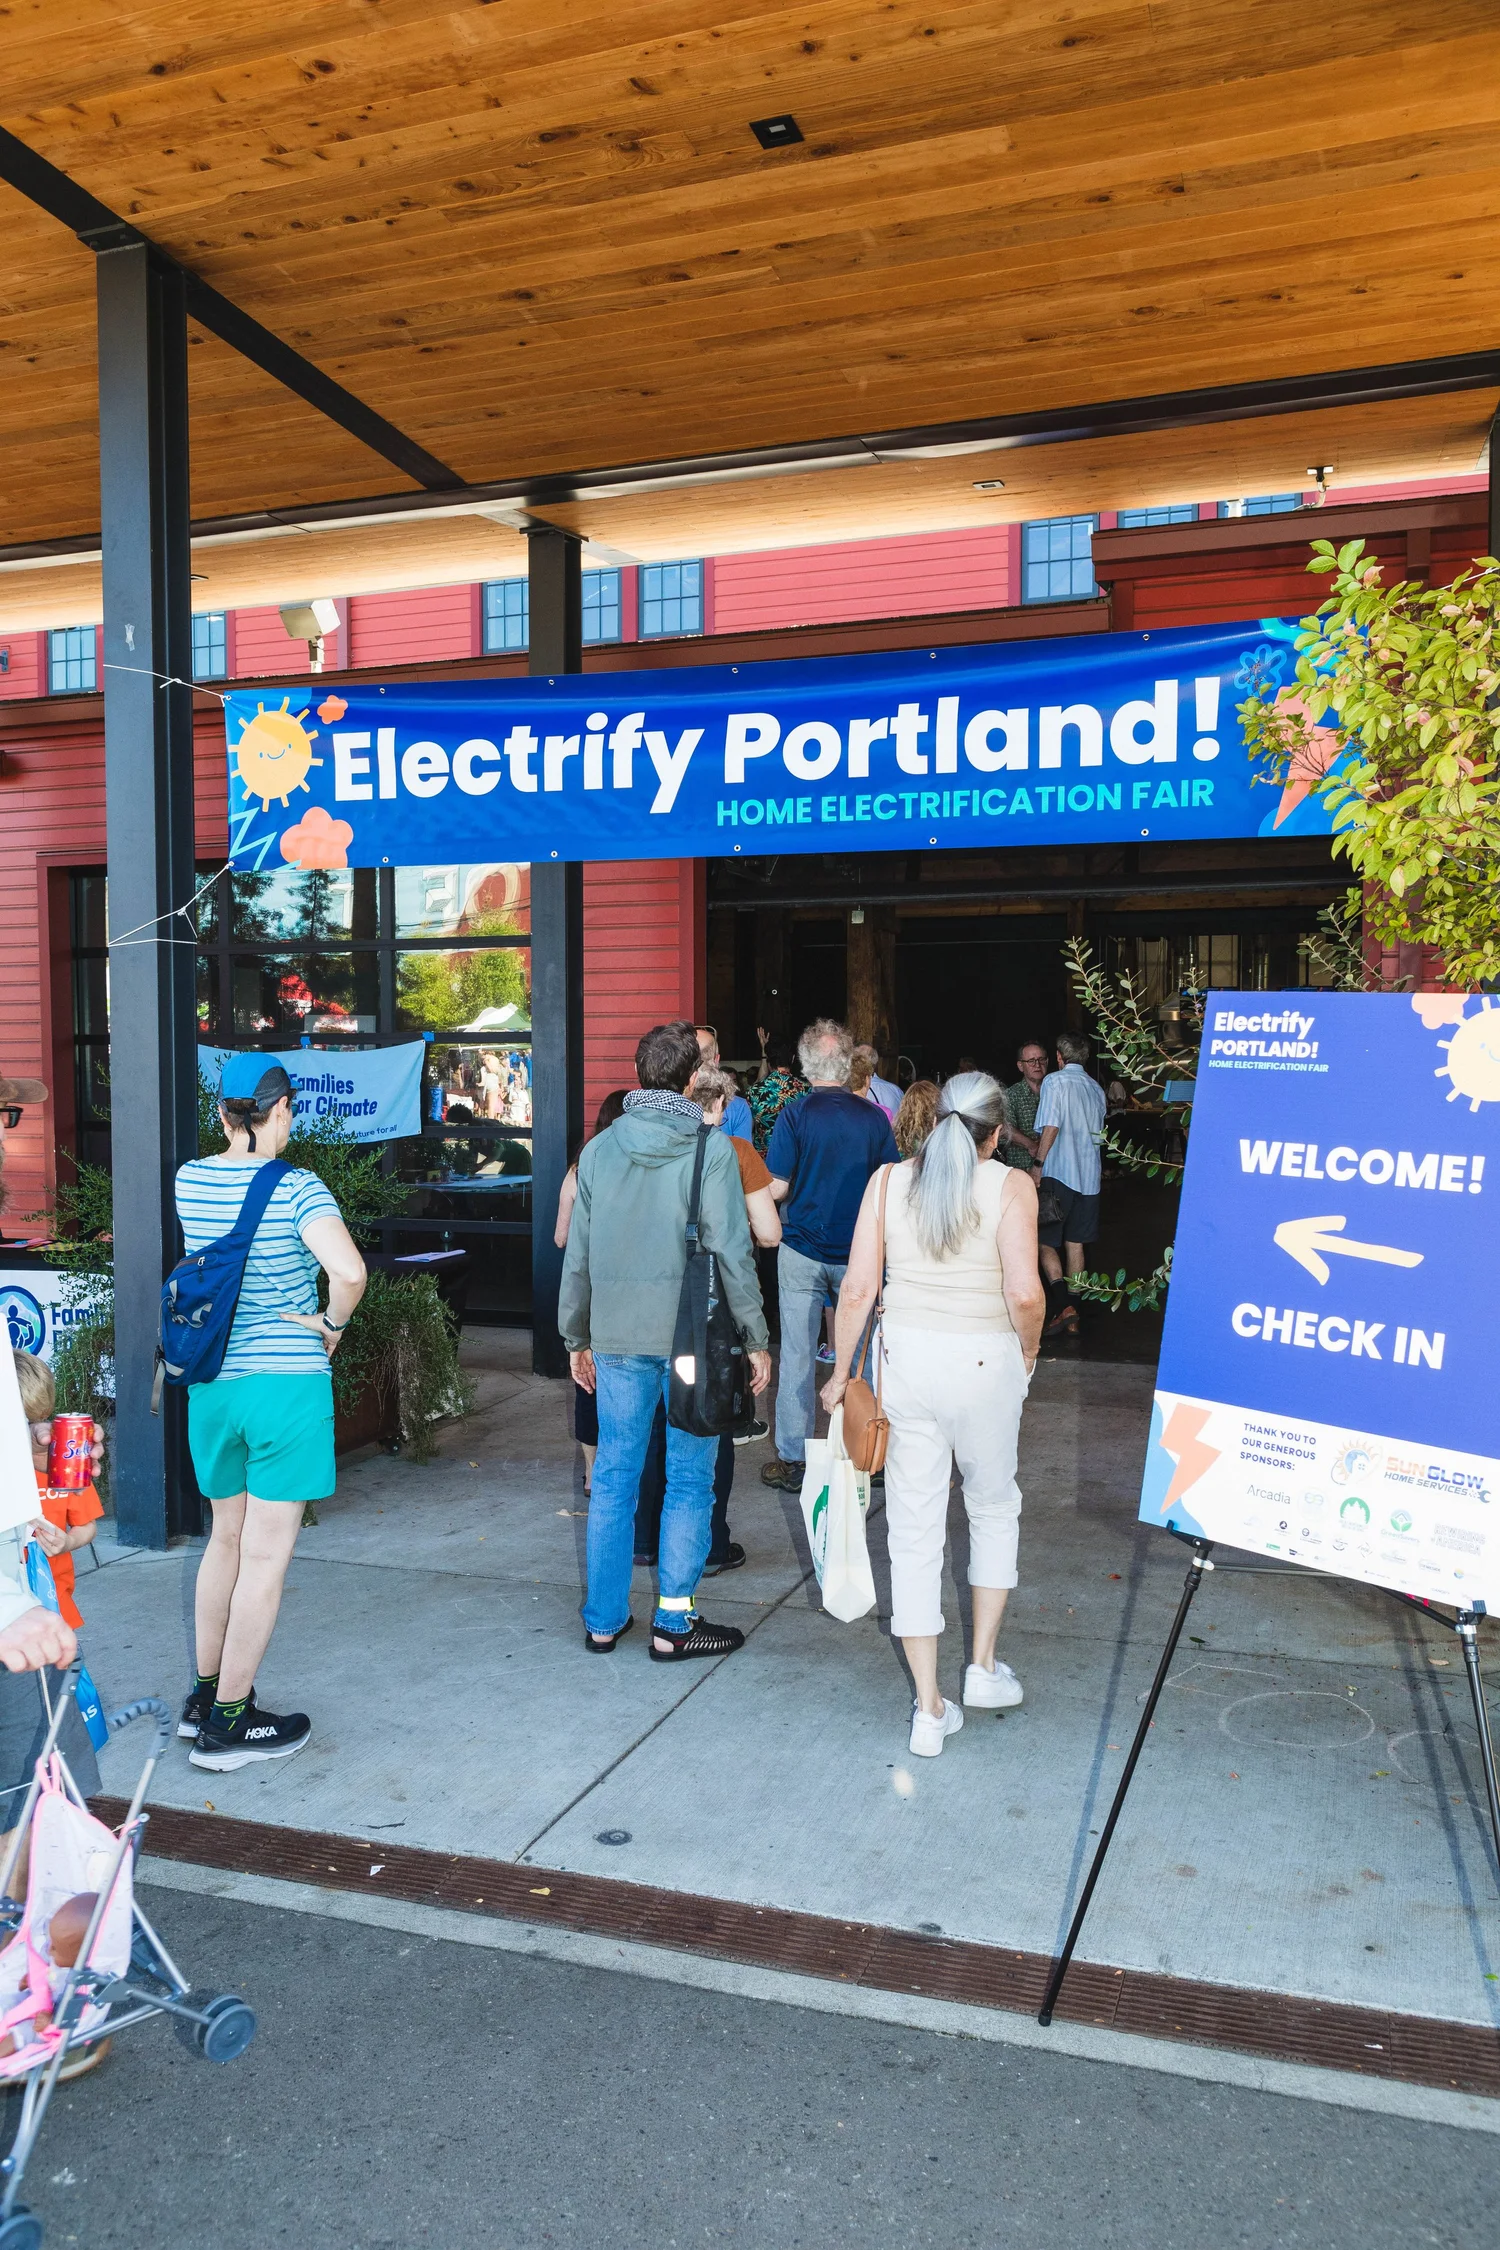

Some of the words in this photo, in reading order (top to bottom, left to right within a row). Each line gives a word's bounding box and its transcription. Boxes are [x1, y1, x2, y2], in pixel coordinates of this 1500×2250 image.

[332, 711, 706, 815] Electrify
[723, 676, 1221, 785] Portland!
[716, 796, 812, 827] HOME
[821, 783, 1122, 823] ELECTRIFICATION
[1132, 778, 1215, 810] FAIR
[1213, 1010, 1316, 1040] Electrify
[1210, 1039, 1320, 1059] PORTLAND!
[1208, 1060, 1234, 1069] HOME
[1234, 1060, 1308, 1072] ELECTRIFICATION
[1308, 1063, 1329, 1073] FAIR
[289, 1073, 355, 1095] amilies
[315, 1095, 378, 1118] Climate
[376, 1127, 389, 1135] for
[389, 1124, 398, 1132] all
[1239, 1138, 1487, 1195] WELCOME!
[1231, 1302, 1387, 1360] CHECK
[1392, 1326, 1446, 1371] IN
[1244, 1422, 1278, 1437] THANK
[1280, 1430, 1302, 1442] YOU
[1303, 1435, 1317, 1445] TO
[1242, 1437, 1262, 1449] OUR
[1263, 1442, 1316, 1461] GENEROUS
[1240, 1451, 1296, 1471] SPONSORS:
[1246, 1484, 1291, 1505] Arcadia
[1383, 1471, 1415, 1485] HOME
[1416, 1478, 1469, 1496] SERVICES
[244, 1725, 278, 1740] HOKA
